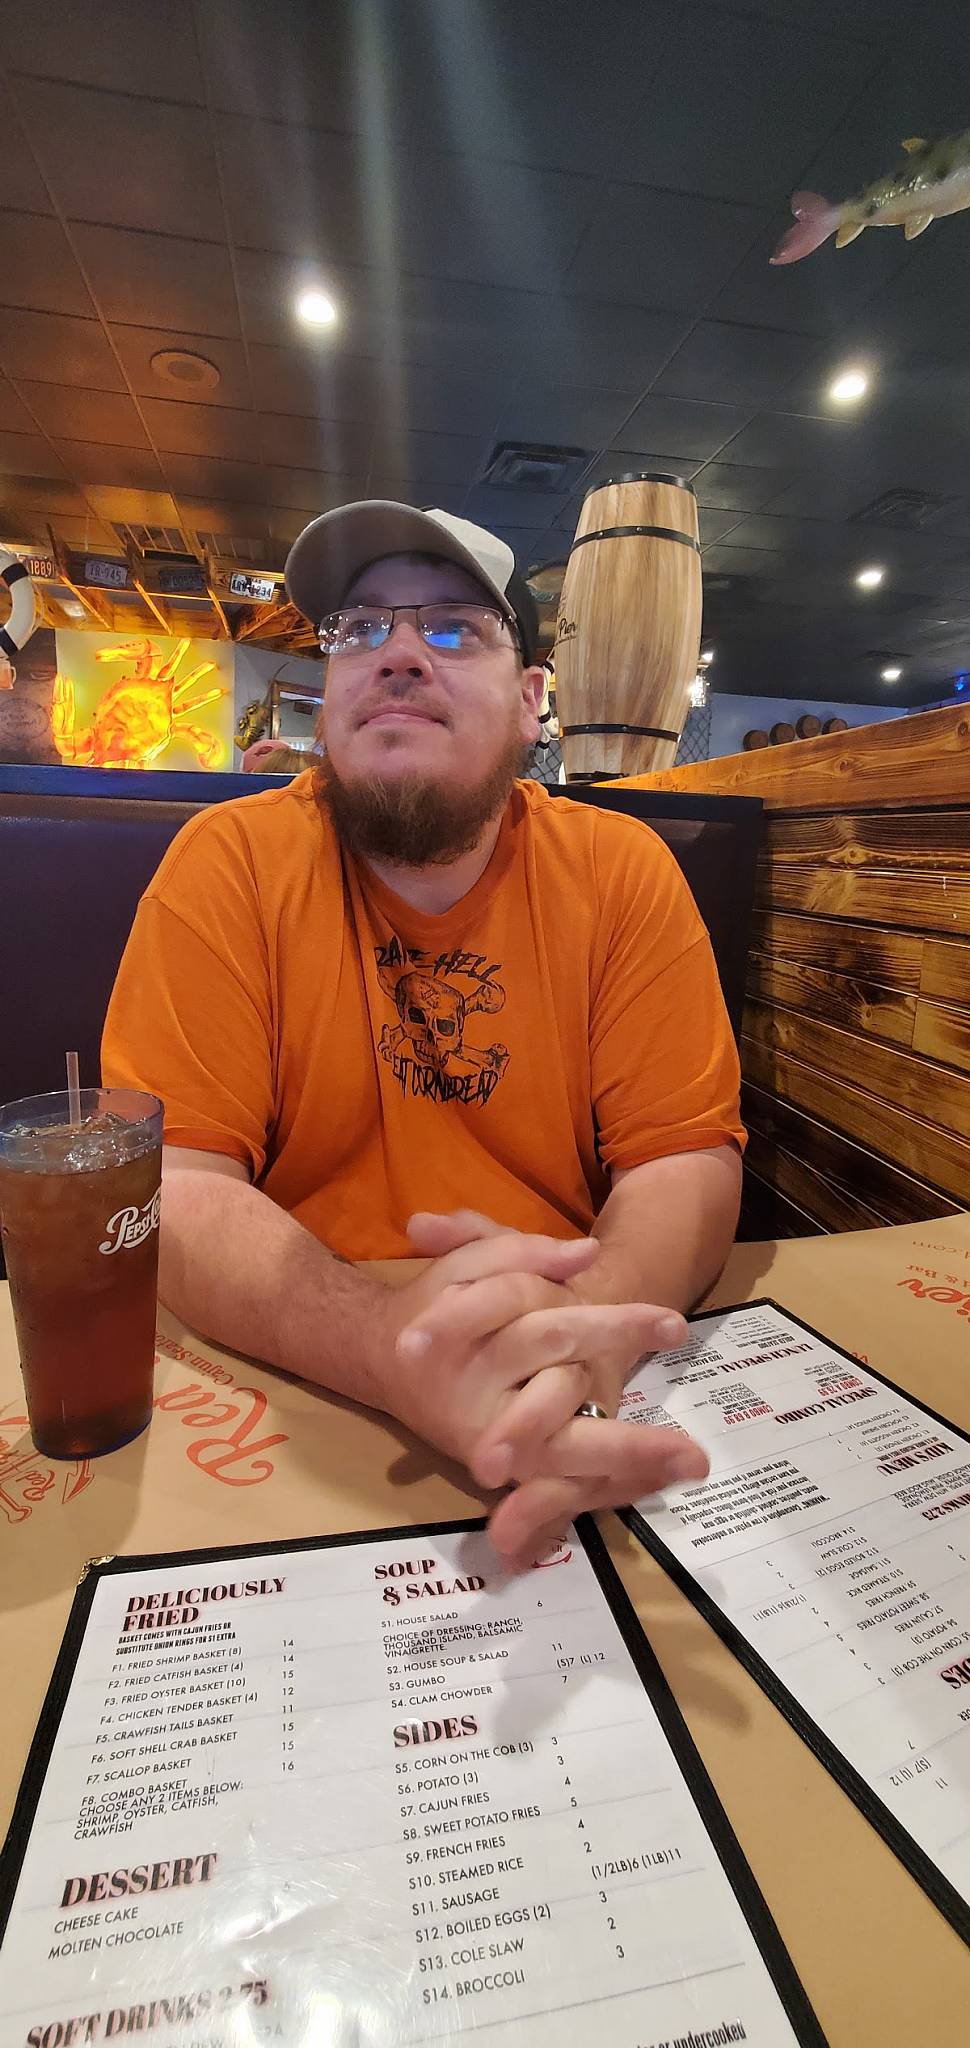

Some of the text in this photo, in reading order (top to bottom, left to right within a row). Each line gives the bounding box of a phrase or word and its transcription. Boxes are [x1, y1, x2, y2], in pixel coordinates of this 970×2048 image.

[191, 1356, 234, 1385] Cajun
[717, 1343, 814, 1373] LUNCH SPECIAL
[775, 1387, 878, 1424] SPECIAL COMBO
[877, 1456, 920, 1477] MENU
[374, 1559, 435, 1580] SOUP
[127, 1577, 286, 1612] DELICIOUSLY
[383, 1575, 486, 1606] & SALAD
[865, 1596, 883, 1608] FRIES
[884, 1586, 907, 1601] FRENCH
[122, 1607, 200, 1632] FRIED
[383, 1632, 419, 1643] CHOICE
[437, 1623, 486, 1636] DRESSING:
[488, 1617, 524, 1629] RANCH,
[397, 1615, 427, 1627] HOUSE
[430, 1611, 458, 1622] SALAD
[116, 1643, 152, 1655] SUBSTITUTE
[154, 1641, 173, 1650] ONION
[175, 1639, 194, 1647] RINGS
[195, 1636, 207, 1644] FOR
[216, 1632, 236, 1641] EXTRA
[118, 1634, 143, 1644] BASKET
[144, 1631, 164, 1640] COMES
[166, 1630, 182, 1638] WITH
[183, 1626, 203, 1635] CAJUN
[204, 1624, 222, 1632] FRIES
[384, 1625, 524, 1651] THOUSAND ISLAND, BALSAMIC
[552, 1643, 563, 1651] 11
[128, 1660, 153, 1670] FRIED
[156, 1655, 190, 1666] SHRIMP
[193, 1650, 226, 1661] BASKET
[229, 1647, 242, 1657] (8)
[387, 1650, 509, 1675] S2. HOUSE SOUP & SALAD
[556, 1658, 574, 1669] (S)7
[594, 1652, 605, 1662] 12
[108, 1662, 243, 1689] F2. FRIED CATFISH BASKET (4)
[283, 1671, 294, 1679] 15
[389, 1675, 445, 1692] S3. GUMBO
[104, 1678, 246, 1707] F3. FRIED OYSTER BASKET (10)
[282, 1687, 294, 1695] 12
[391, 1686, 493, 1709] S4. CLAM CHOWDER
[100, 1692, 258, 1725] F4. CHICKEN TENDER BASKET (4)
[282, 1705, 293, 1713] 11
[96, 1714, 234, 1744] F5. CRAWFISH TAILS BASKET
[282, 1723, 294, 1731] 15
[392, 1714, 478, 1748] SIDES
[92, 1732, 238, 1764] F6. SOFT SHELL CRAB BASKET
[282, 1741, 294, 1751] 15
[395, 1741, 534, 1774] S5. CORN ON THE COB (3)
[104, 1766, 150, 1782] SCALLOP
[153, 1758, 192, 1773] BASKET
[282, 1762, 294, 1771] 16
[82, 1779, 188, 1807] F8. COMBO BASKET
[398, 1771, 479, 1795] S6. POTATO (3)
[80, 1781, 244, 1817] CHOOSE ANY 2 ITEMS BELOW:
[124, 1805, 167, 1820] OYSTER,
[172, 1796, 218, 1812] CATFISH,
[400, 1791, 490, 1818] S7. CAJUN FRIES
[74, 1822, 133, 1840] CRAWFISH
[403, 1805, 541, 1841] S8. SWEET POTATO FRIES
[406, 1835, 506, 1865] S9. FRENCH FRIES
[59, 1853, 218, 1908] DESSERT
[409, 1857, 524, 1891] S10. STEAMED RICE
[412, 1887, 500, 1917] S11. SAUSAGE
[54, 1906, 139, 1934] CHEESE CAKE
[415, 1903, 551, 1944] S12. BOILED EGGS (2)
[48, 1921, 184, 1960] MOLTEN CHOCOLATE
[419, 1937, 525, 1973] S13. COLE SLAW
[423, 1969, 526, 2005] S14. BROCCOLI
[25, 2013, 101, 2048] SOFT
